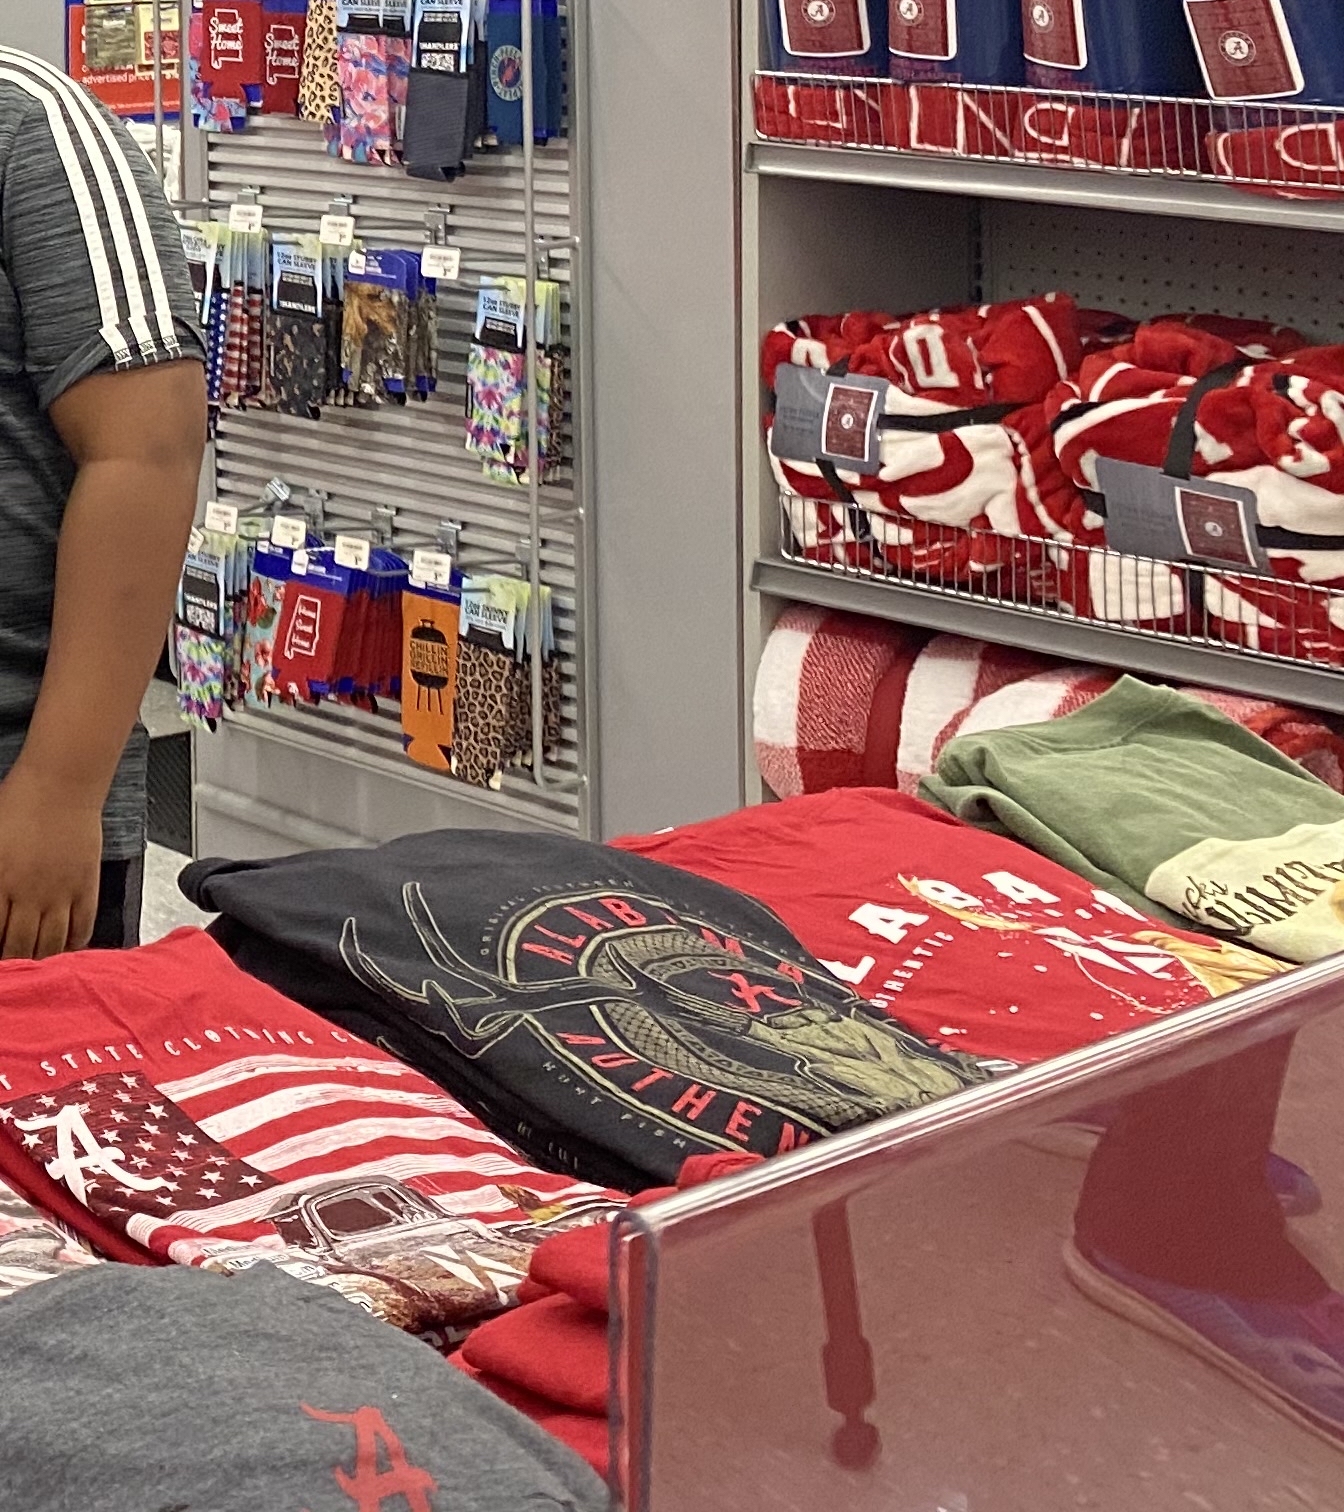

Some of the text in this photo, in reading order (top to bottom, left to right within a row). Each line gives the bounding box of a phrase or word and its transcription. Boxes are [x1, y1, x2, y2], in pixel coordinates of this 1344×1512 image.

[209, 16, 243, 34] Sweet
[210, 33, 243, 51] Home
[264, 33, 299, 51] Sweet
[265, 49, 299, 67] Home
[82, 71, 128, 85] advertised
[41, 1043, 145, 1077] STATE
[163, 1023, 315, 1058] CLOTHING
